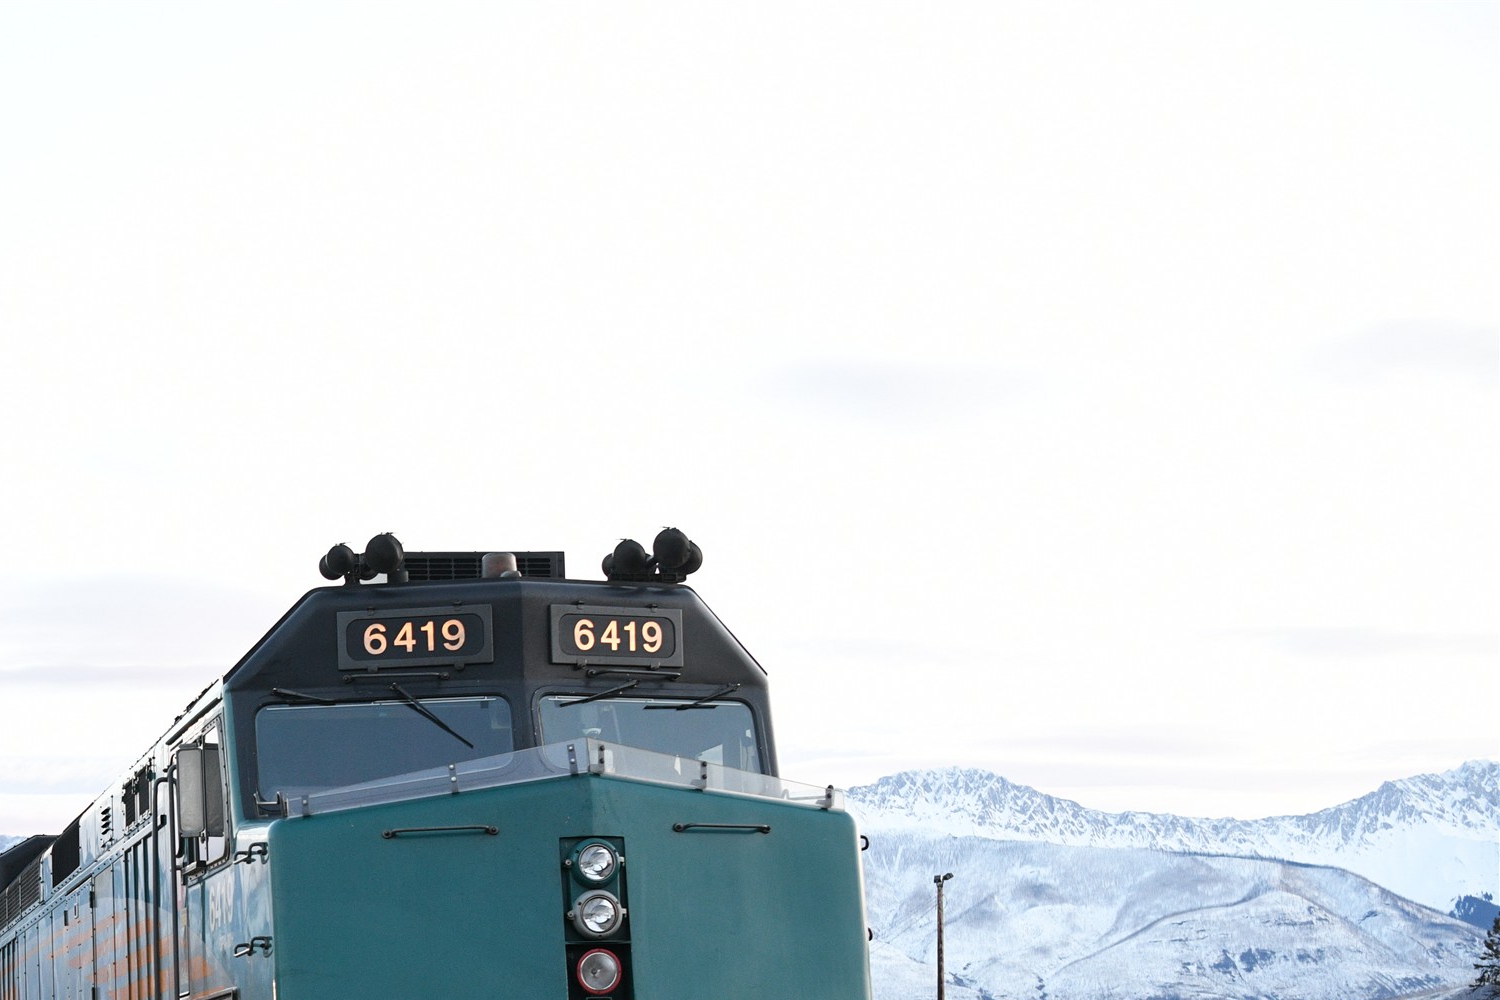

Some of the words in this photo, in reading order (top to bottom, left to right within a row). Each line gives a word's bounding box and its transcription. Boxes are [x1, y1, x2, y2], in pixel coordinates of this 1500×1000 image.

[363, 619, 466, 655] 6419
[573, 619, 663, 653] 6419
[209, 874, 235, 932] 6419
